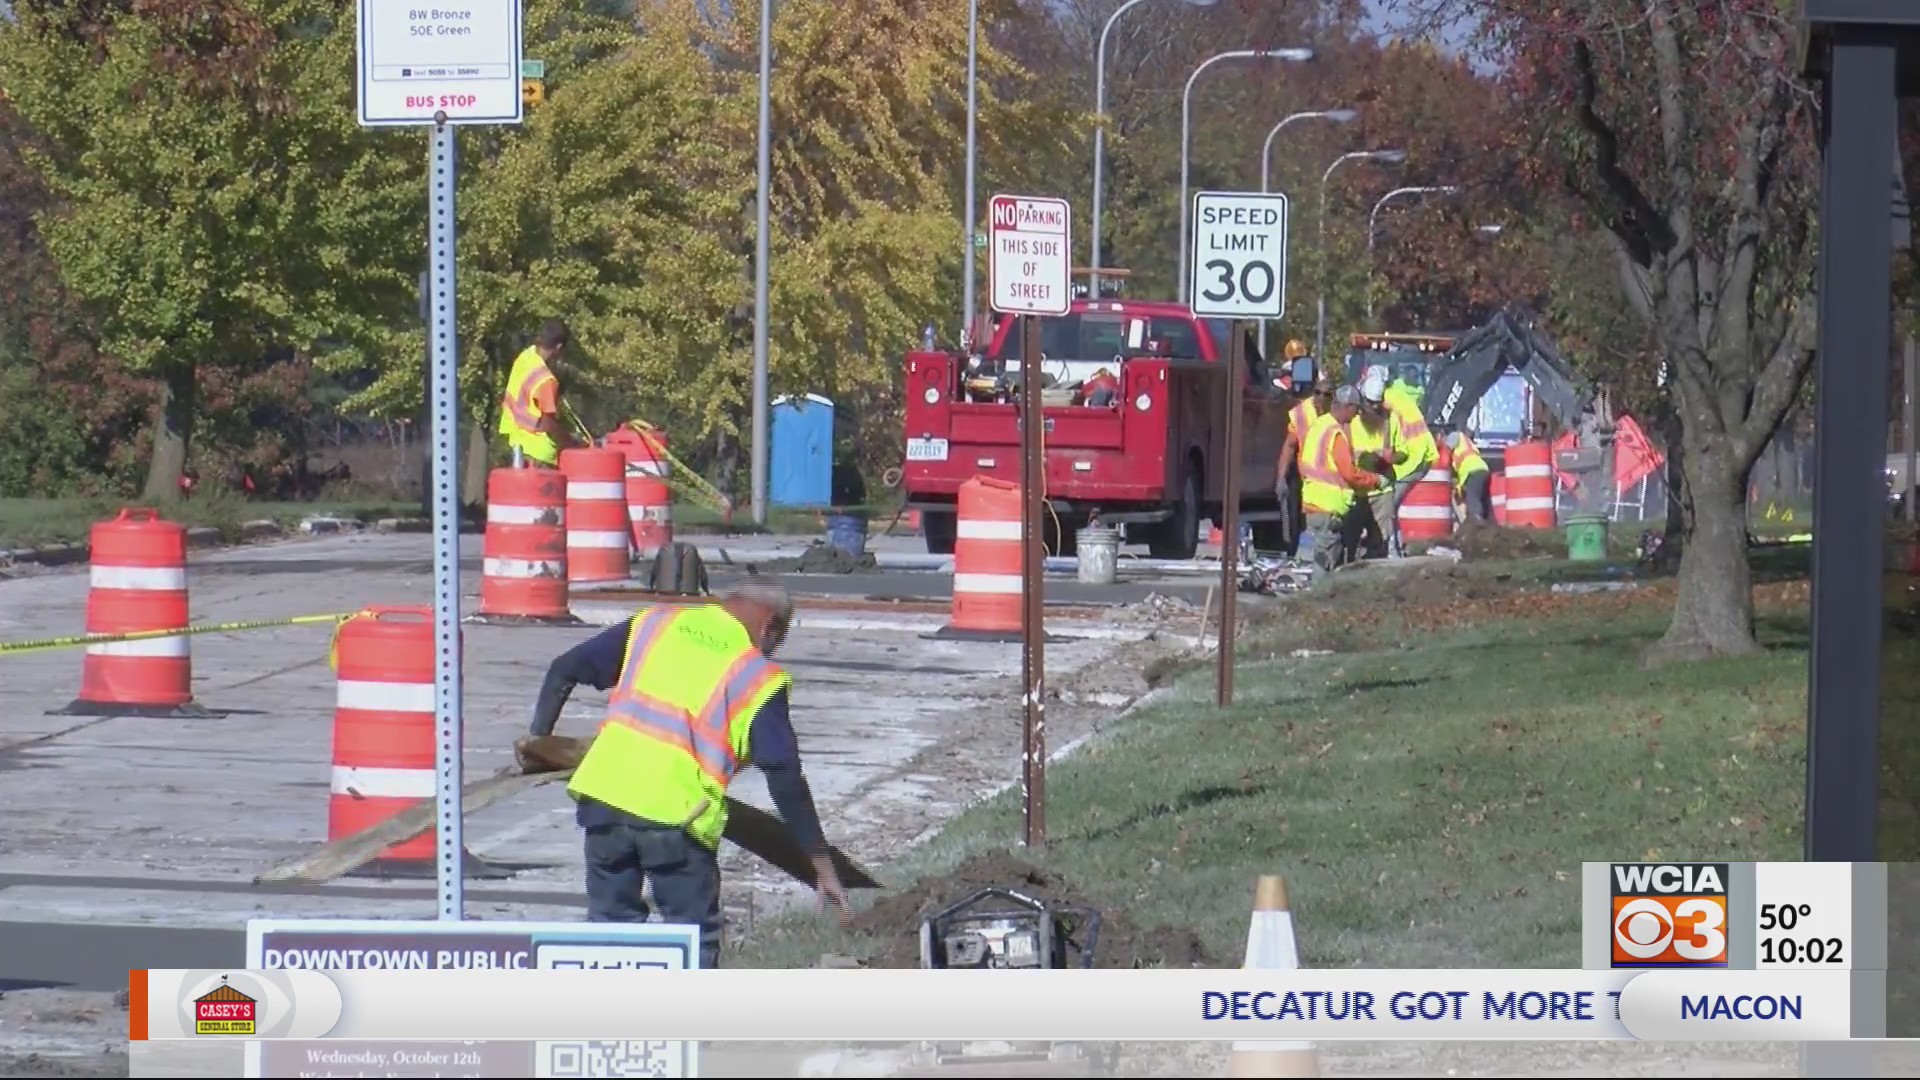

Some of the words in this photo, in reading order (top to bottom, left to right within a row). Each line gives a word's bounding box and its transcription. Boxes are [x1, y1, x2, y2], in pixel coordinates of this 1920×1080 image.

[409, 10, 427, 19] 8W
[432, 9, 471, 19] Bronze
[411, 26, 432, 36] 50E
[437, 25, 471, 35] Green
[406, 96, 434, 107] BUS
[440, 95, 476, 107] STOP
[994, 203, 1016, 226] NO
[1018, 208, 1062, 225] PARKING
[1203, 207, 1278, 225] SPEED
[1002, 238, 1028, 254] THIS
[1032, 240, 1058, 256] SIDE
[1210, 233, 1268, 252] LIMIT
[1023, 262, 1037, 276] OF
[1202, 259, 1275, 304] 30
[1010, 283, 1051, 300] STREET
[264, 949, 428, 969] DOWNTOWN
[436, 950, 529, 969] PUBLIC
[306, 1050, 390, 1067] Wednesday,
[393, 1051, 449, 1065] October
[454, 1051, 481, 1065] 12th
